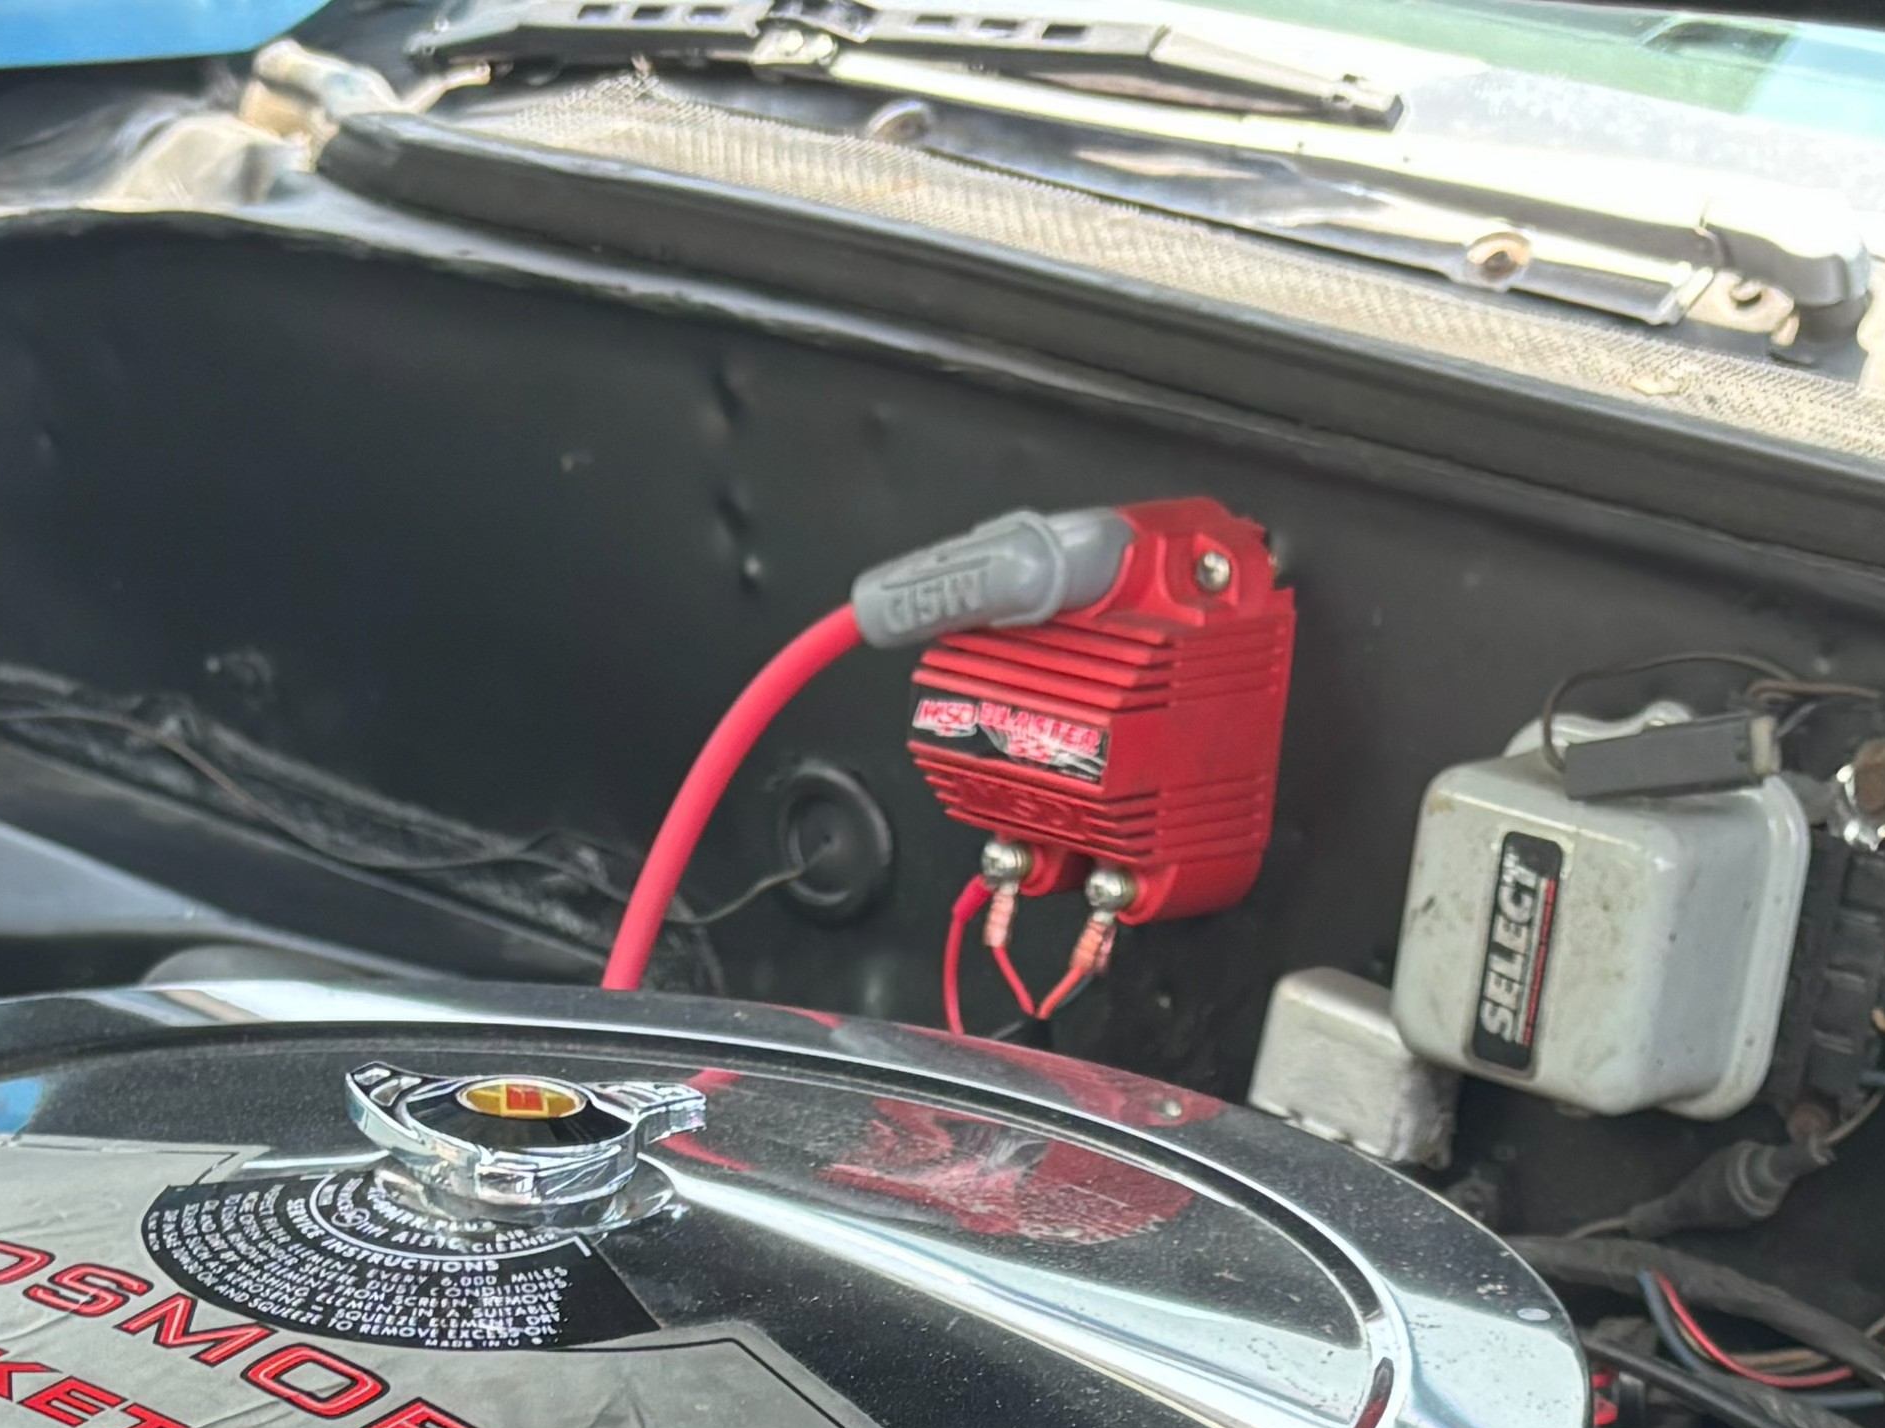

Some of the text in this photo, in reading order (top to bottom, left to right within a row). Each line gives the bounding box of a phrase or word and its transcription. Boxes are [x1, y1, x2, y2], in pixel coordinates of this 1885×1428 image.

[1480, 847, 1537, 1042] SELECT
[286, 1197, 325, 1238] SERVICE
[321, 1238, 498, 1272] INSTRUCTIONS
[510, 1266, 567, 1283] MILES
[411, 1307, 433, 1317] IN
[472, 1301, 557, 1318] SUITABLE
[327, 1316, 353, 1331] TO
[359, 1323, 438, 1338] REMOVE
